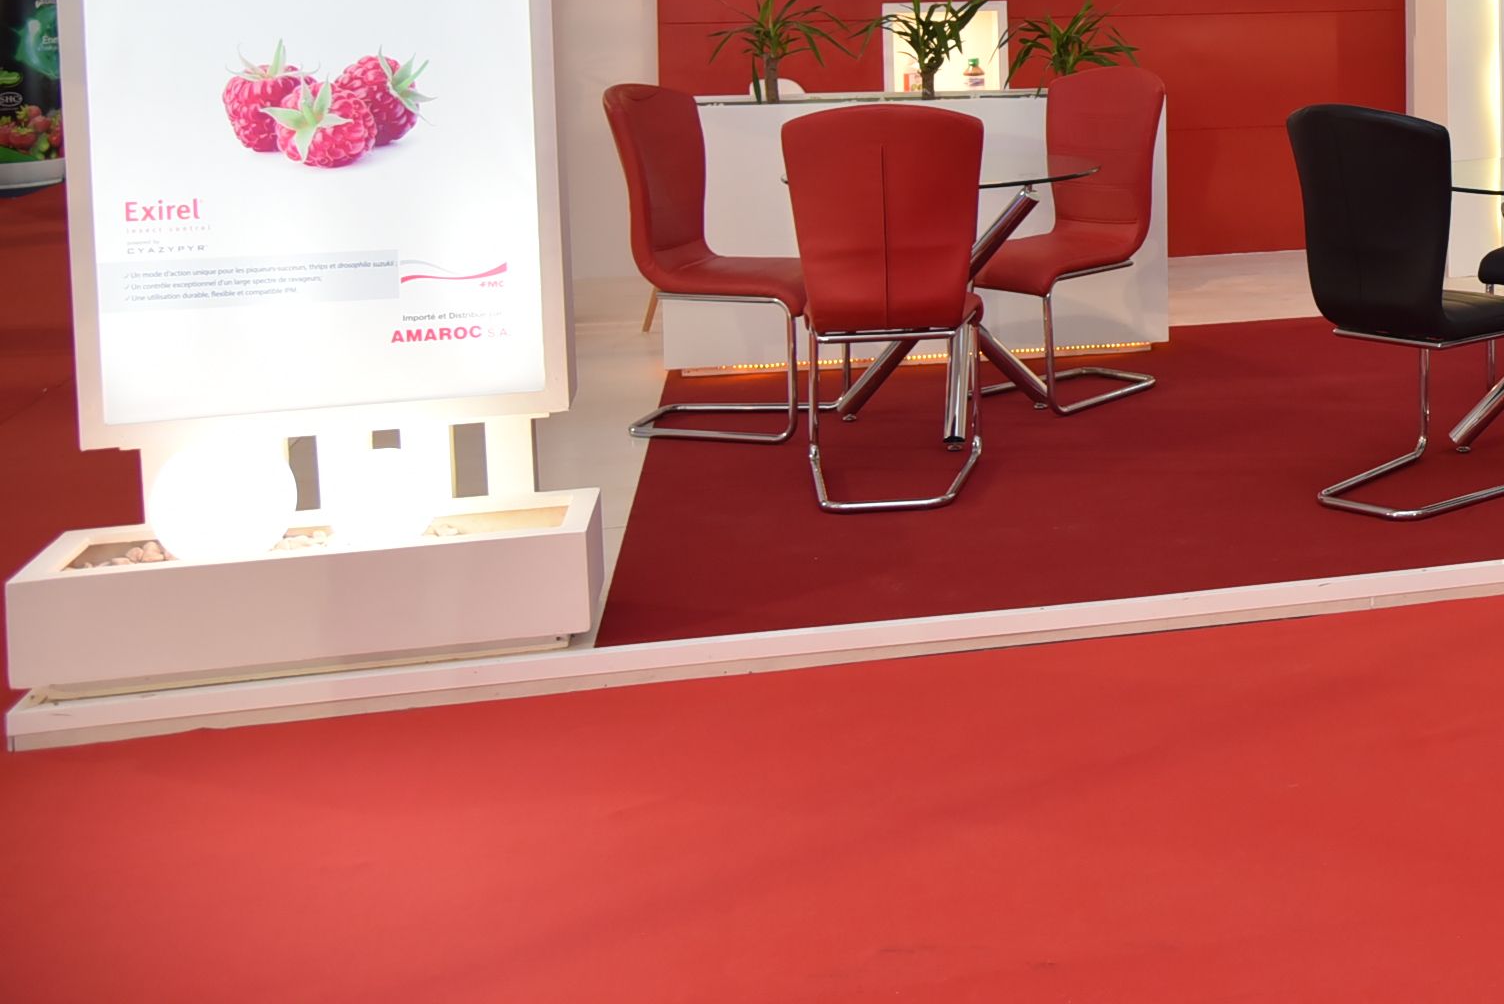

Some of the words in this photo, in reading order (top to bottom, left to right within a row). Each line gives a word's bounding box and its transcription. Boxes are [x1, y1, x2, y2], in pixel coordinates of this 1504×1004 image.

[125, 198, 201, 222] Exirel
[402, 312, 436, 323] Importé
[438, 312, 447, 320] et
[391, 325, 482, 343] AMAROC
